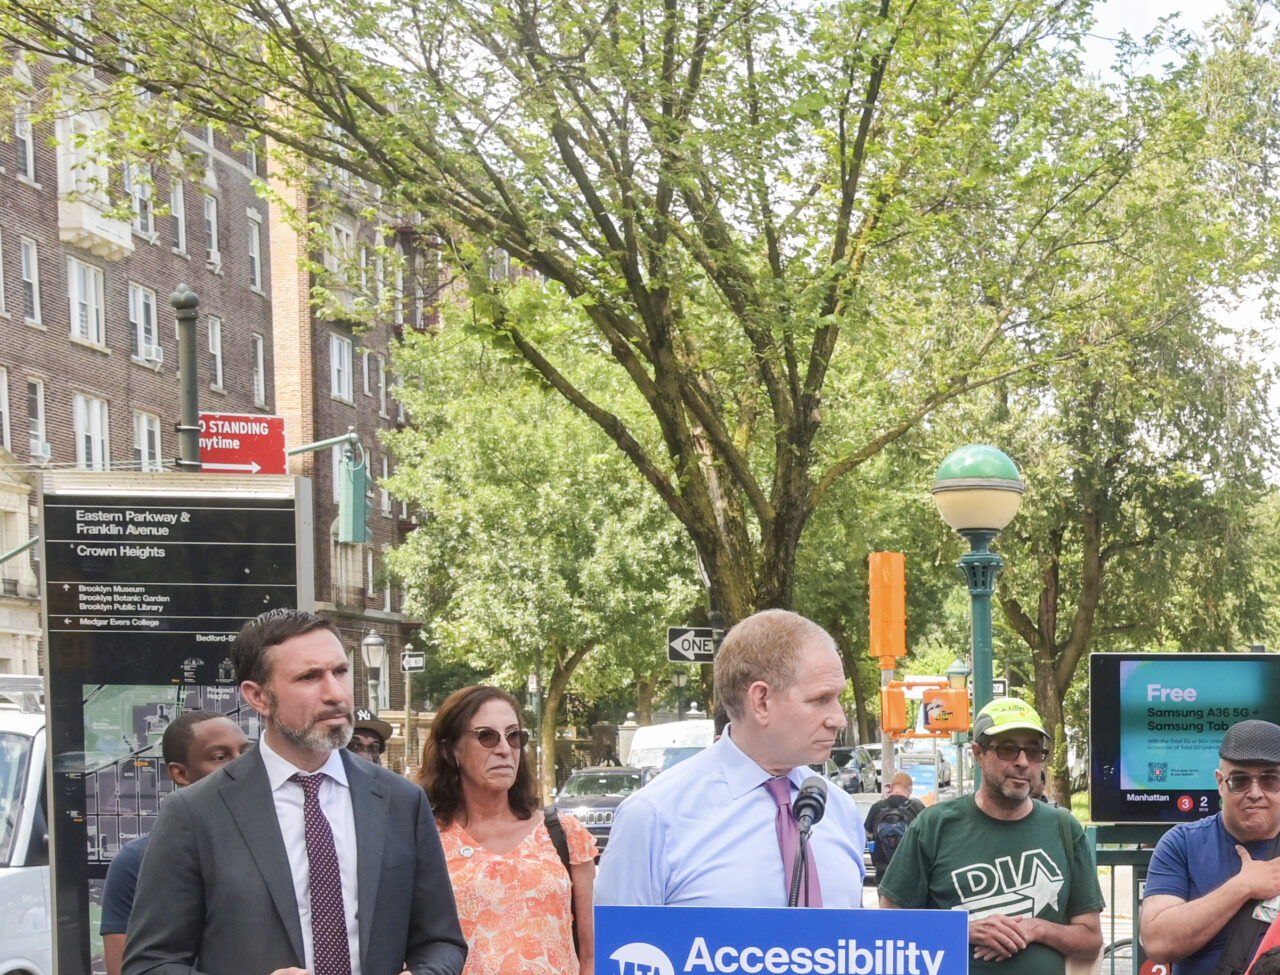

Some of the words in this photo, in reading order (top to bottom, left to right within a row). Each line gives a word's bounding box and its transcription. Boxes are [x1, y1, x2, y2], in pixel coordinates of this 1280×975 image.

[209, 420, 269, 435] STANDING
[199, 436, 240, 451] nytime
[76, 509, 123, 522] Eastern
[125, 510, 178, 525] Parkway
[180, 511, 191, 523] &
[76, 523, 123, 535] Franklin
[126, 524, 170, 536] Avenue
[77, 545, 117, 557] Crown
[120, 546, 165, 559] Heights
[78, 585, 112, 594] Brooklyn
[113, 585, 145, 593] Museum
[79, 594, 112, 602] Brooklyn
[113, 594, 141, 602] Botanic
[79, 603, 112, 612] Brooklyn
[113, 603, 136, 611] Public
[137, 604, 163, 613] Library
[80, 618, 108, 627] Medgar
[110, 618, 130, 626] Evers
[131, 619, 159, 628] College
[681, 638, 712, 652] ONE
[1147, 684, 1197, 702] Free
[1147, 708, 1204, 719] Samsung
[1207, 708, 1230, 718] A36
[1233, 708, 1249, 718] 5G
[1147, 721, 1204, 733] Samsung
[1207, 721, 1230, 731] Tab
[1127, 793, 1170, 802] Manhattan
[1182, 798, 1190, 809] 3
[1200, 796, 1209, 807] 2
